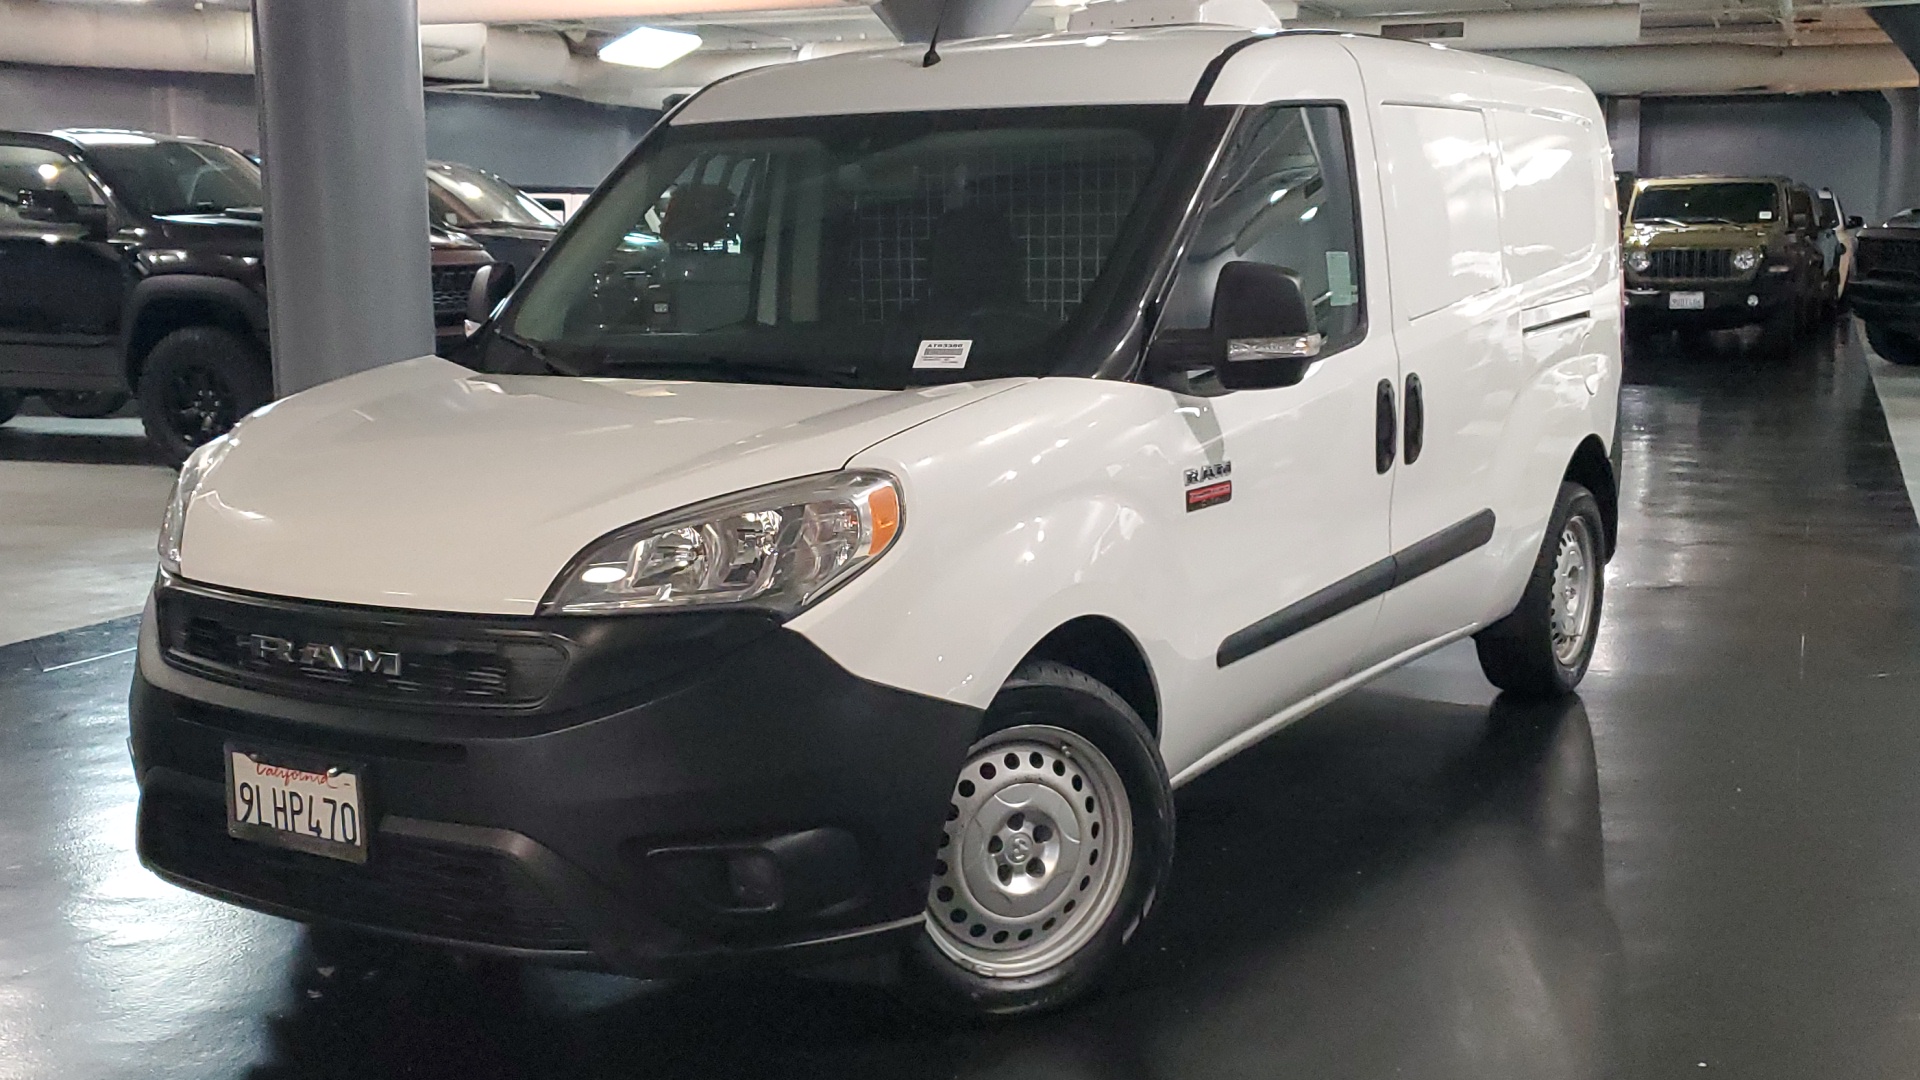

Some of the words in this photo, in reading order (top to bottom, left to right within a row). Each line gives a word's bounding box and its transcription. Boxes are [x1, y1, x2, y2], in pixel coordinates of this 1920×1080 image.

[1184, 460, 1231, 486] RAM
[250, 633, 400, 677] RAM
[239, 782, 357, 844] 9LHP470
